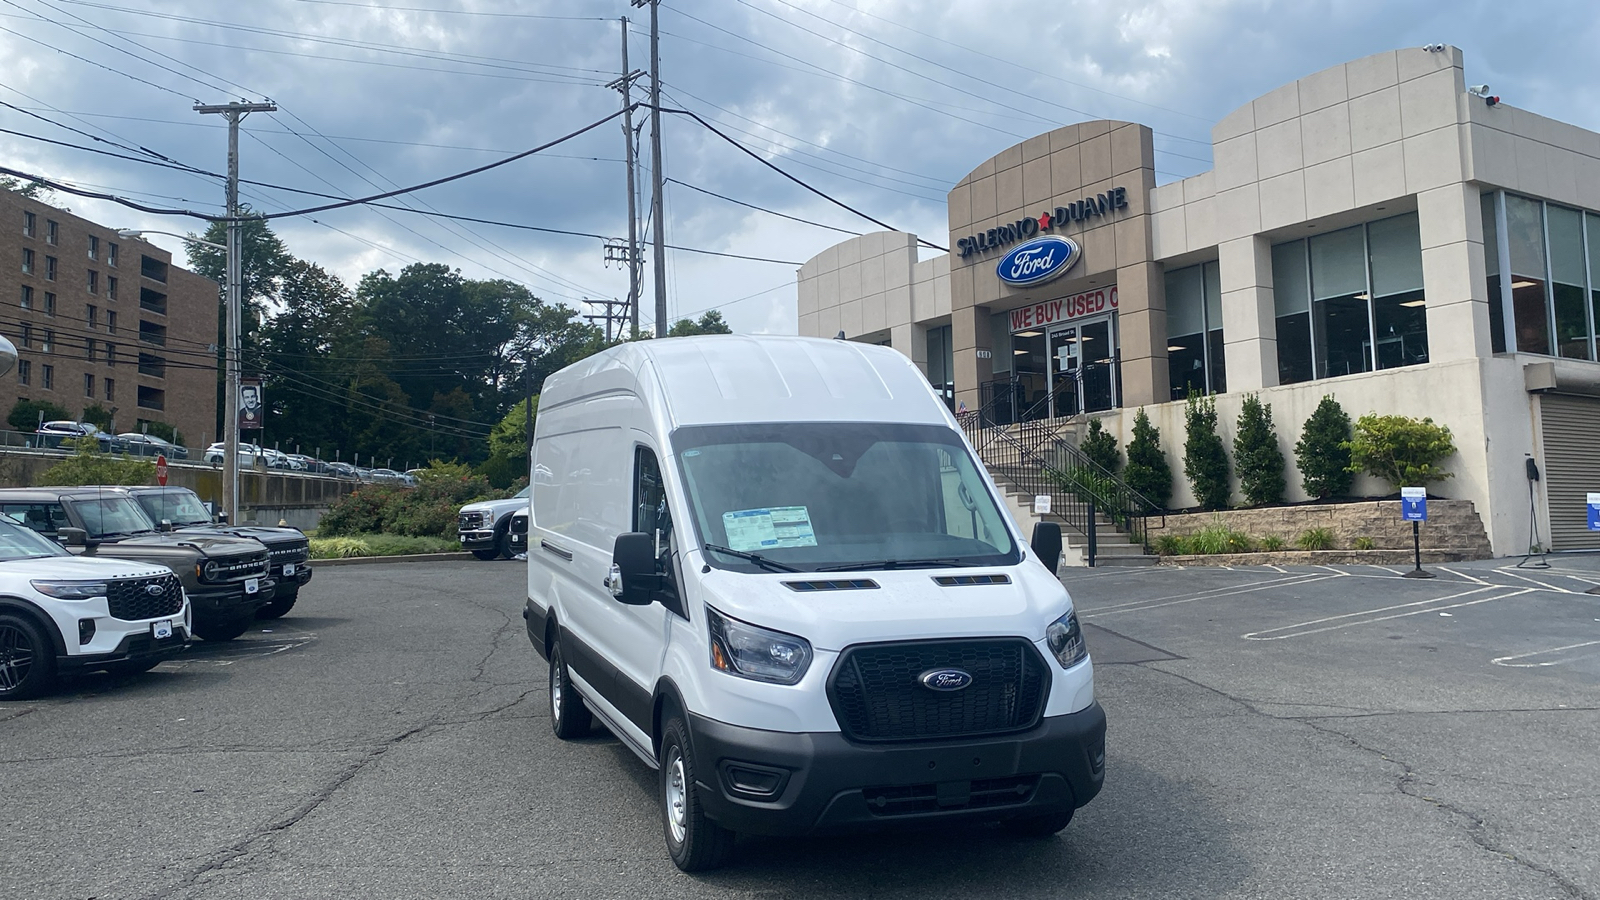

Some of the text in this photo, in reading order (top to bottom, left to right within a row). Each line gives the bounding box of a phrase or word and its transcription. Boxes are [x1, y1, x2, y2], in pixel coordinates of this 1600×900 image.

[957, 186, 1129, 258] SALERNO DUANE
[1011, 246, 1054, 278] Ford
[1011, 307, 1032, 330] WE
[1035, 300, 1063, 325] BUY
[1066, 291, 1105, 318] USED
[229, 561, 264, 571] BRONCO
[936, 673, 963, 687] Ford
